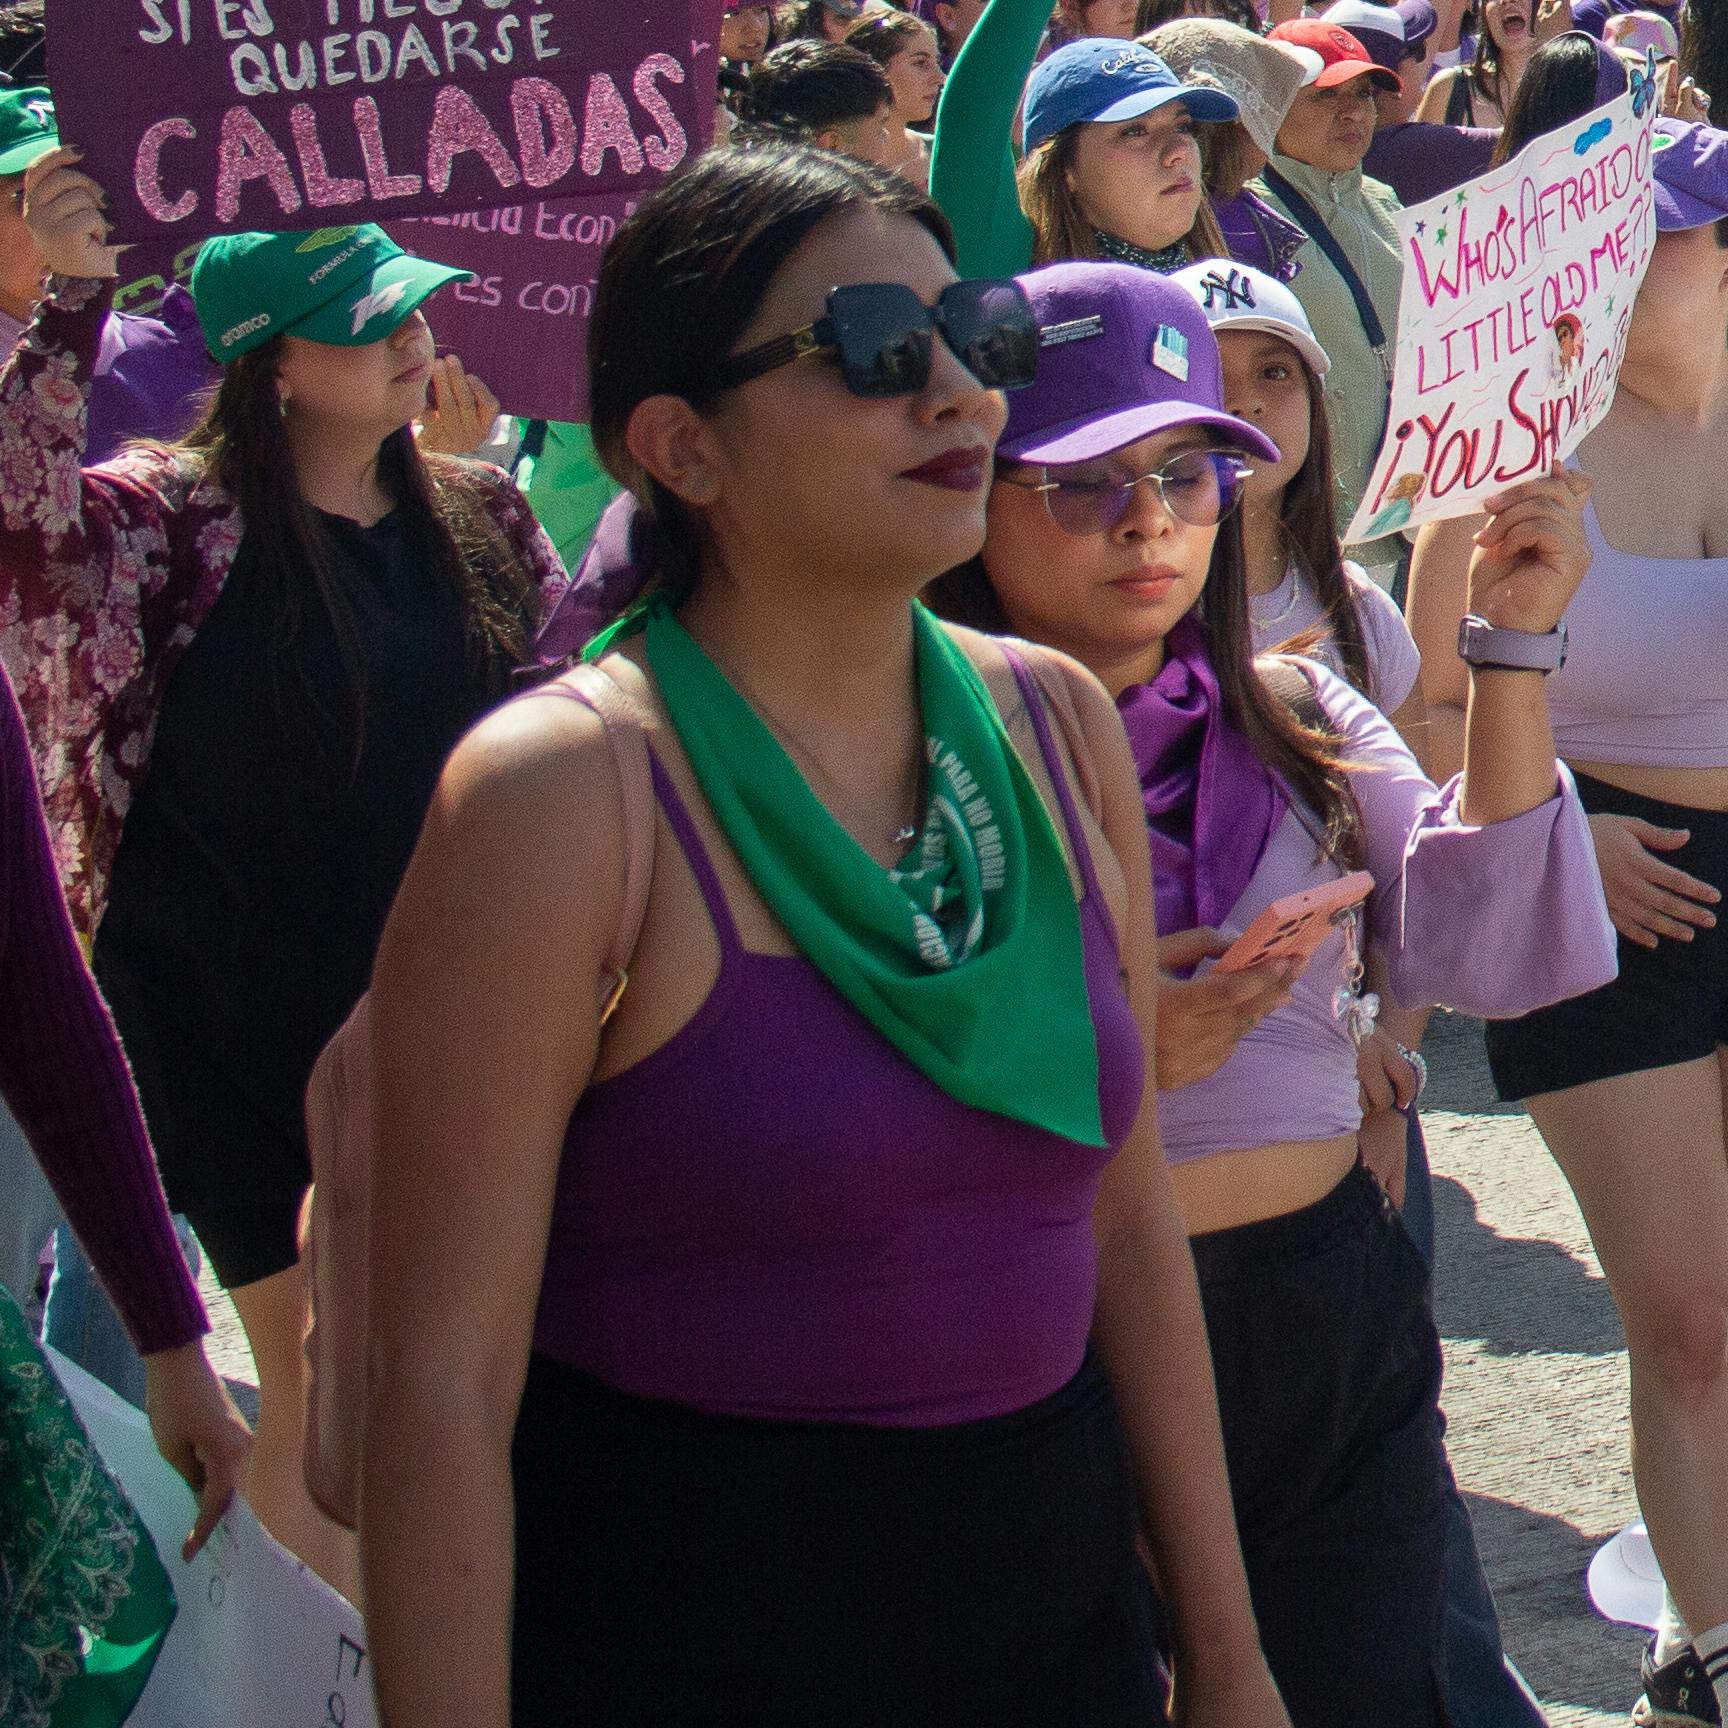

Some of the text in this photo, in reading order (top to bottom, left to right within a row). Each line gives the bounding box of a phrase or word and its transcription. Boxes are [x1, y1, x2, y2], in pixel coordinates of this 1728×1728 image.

[228, 12, 560, 96] QUEDARSE
[133, 52, 690, 225] CALLADAS
[1514, 150, 1629, 254] AFRAID
[220, 312, 271, 348] aramco
[1412, 298, 1535, 396] LITTLE
[1539, 267, 1596, 332] OLD
